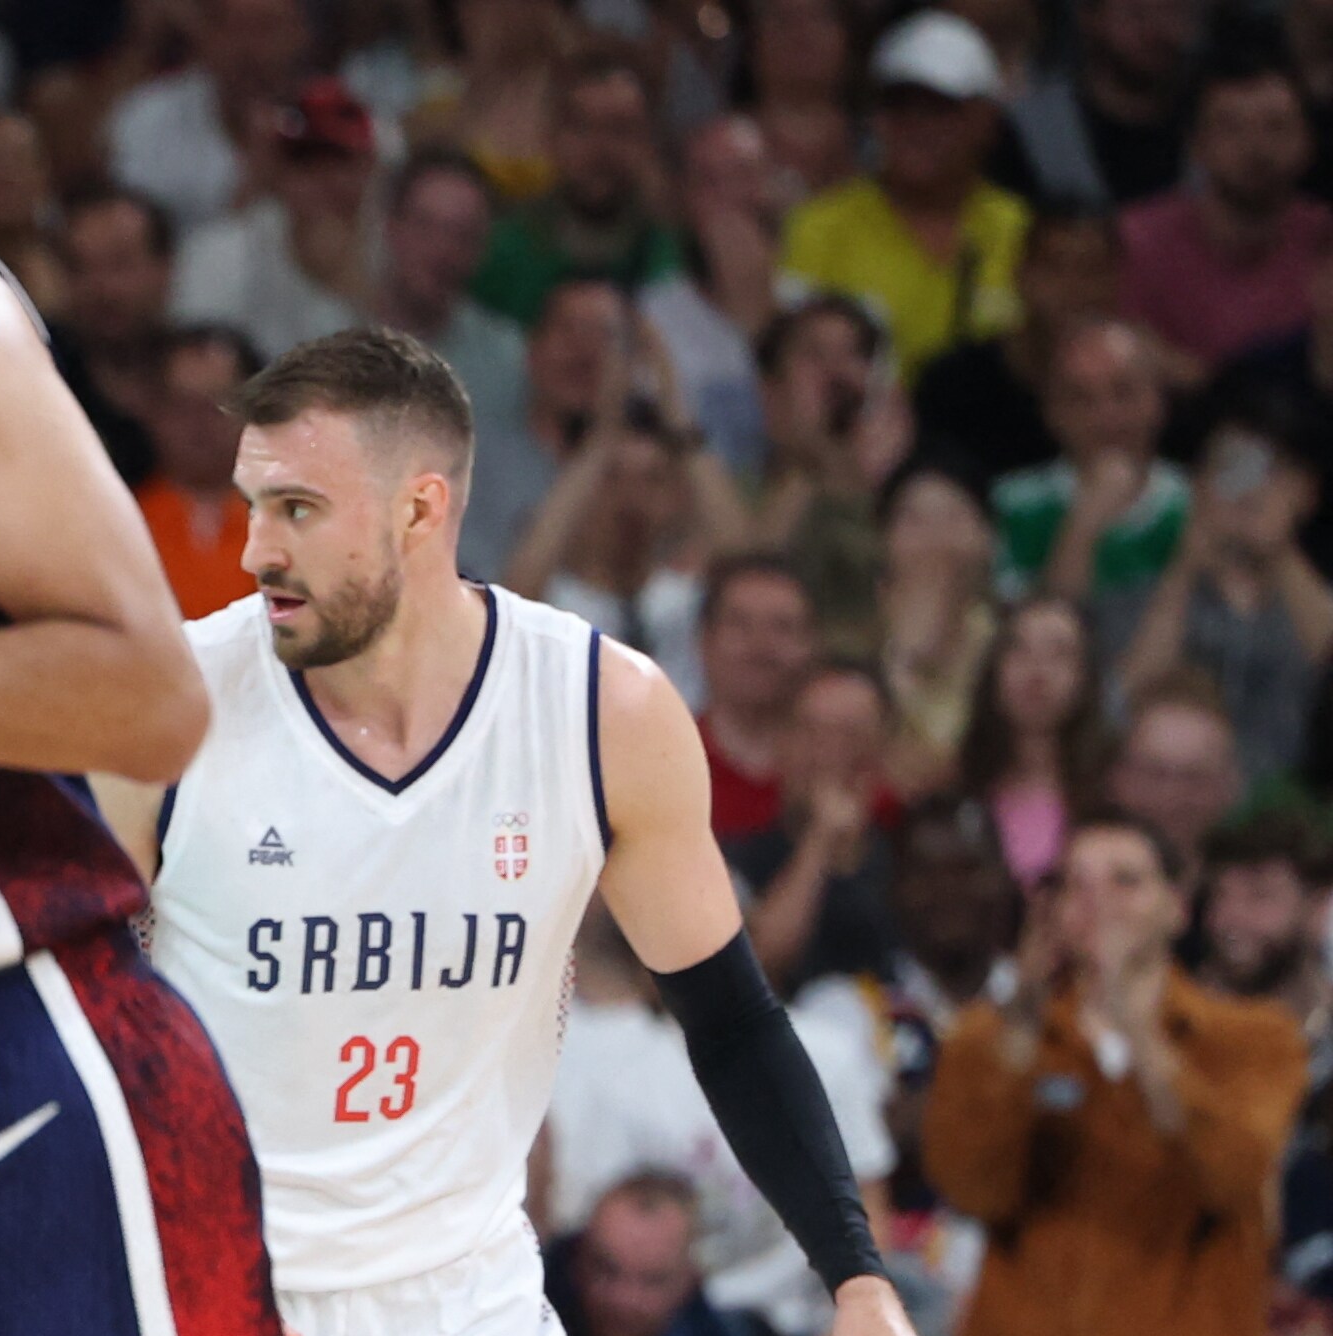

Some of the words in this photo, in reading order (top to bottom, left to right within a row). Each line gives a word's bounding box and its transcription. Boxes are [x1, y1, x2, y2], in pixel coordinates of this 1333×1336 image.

[248, 848, 296, 868] PEAK
[246, 911, 527, 995] SRBIJA
[332, 1034, 421, 1124] 23
